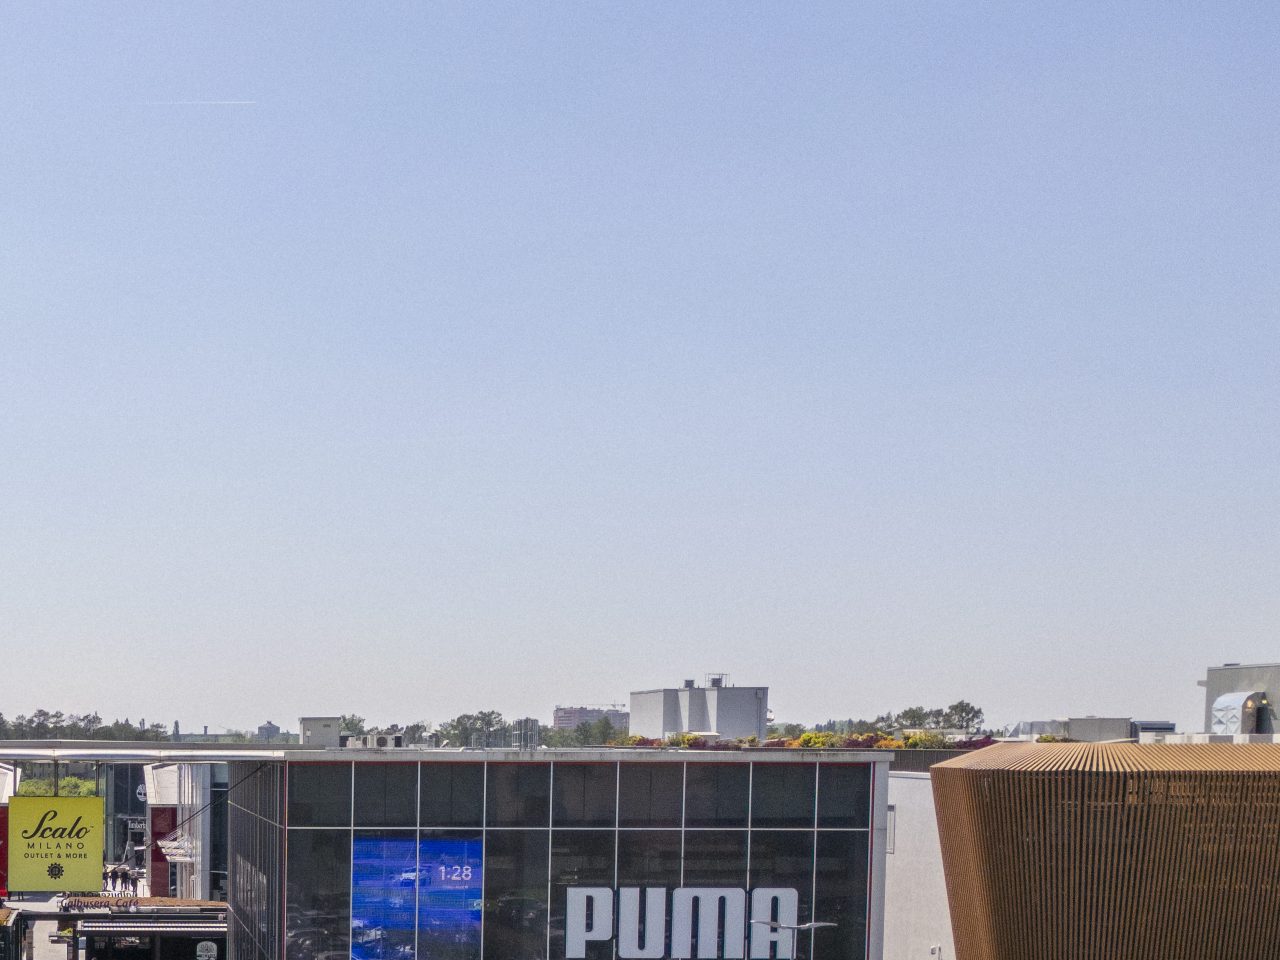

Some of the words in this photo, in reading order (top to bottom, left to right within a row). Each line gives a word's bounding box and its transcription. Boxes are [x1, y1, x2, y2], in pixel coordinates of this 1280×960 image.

[22, 810, 90, 839] Scalo
[27, 842, 84, 850] MILANO
[438, 866, 472, 881] 1:28
[566, 887, 798, 959] PUMA
